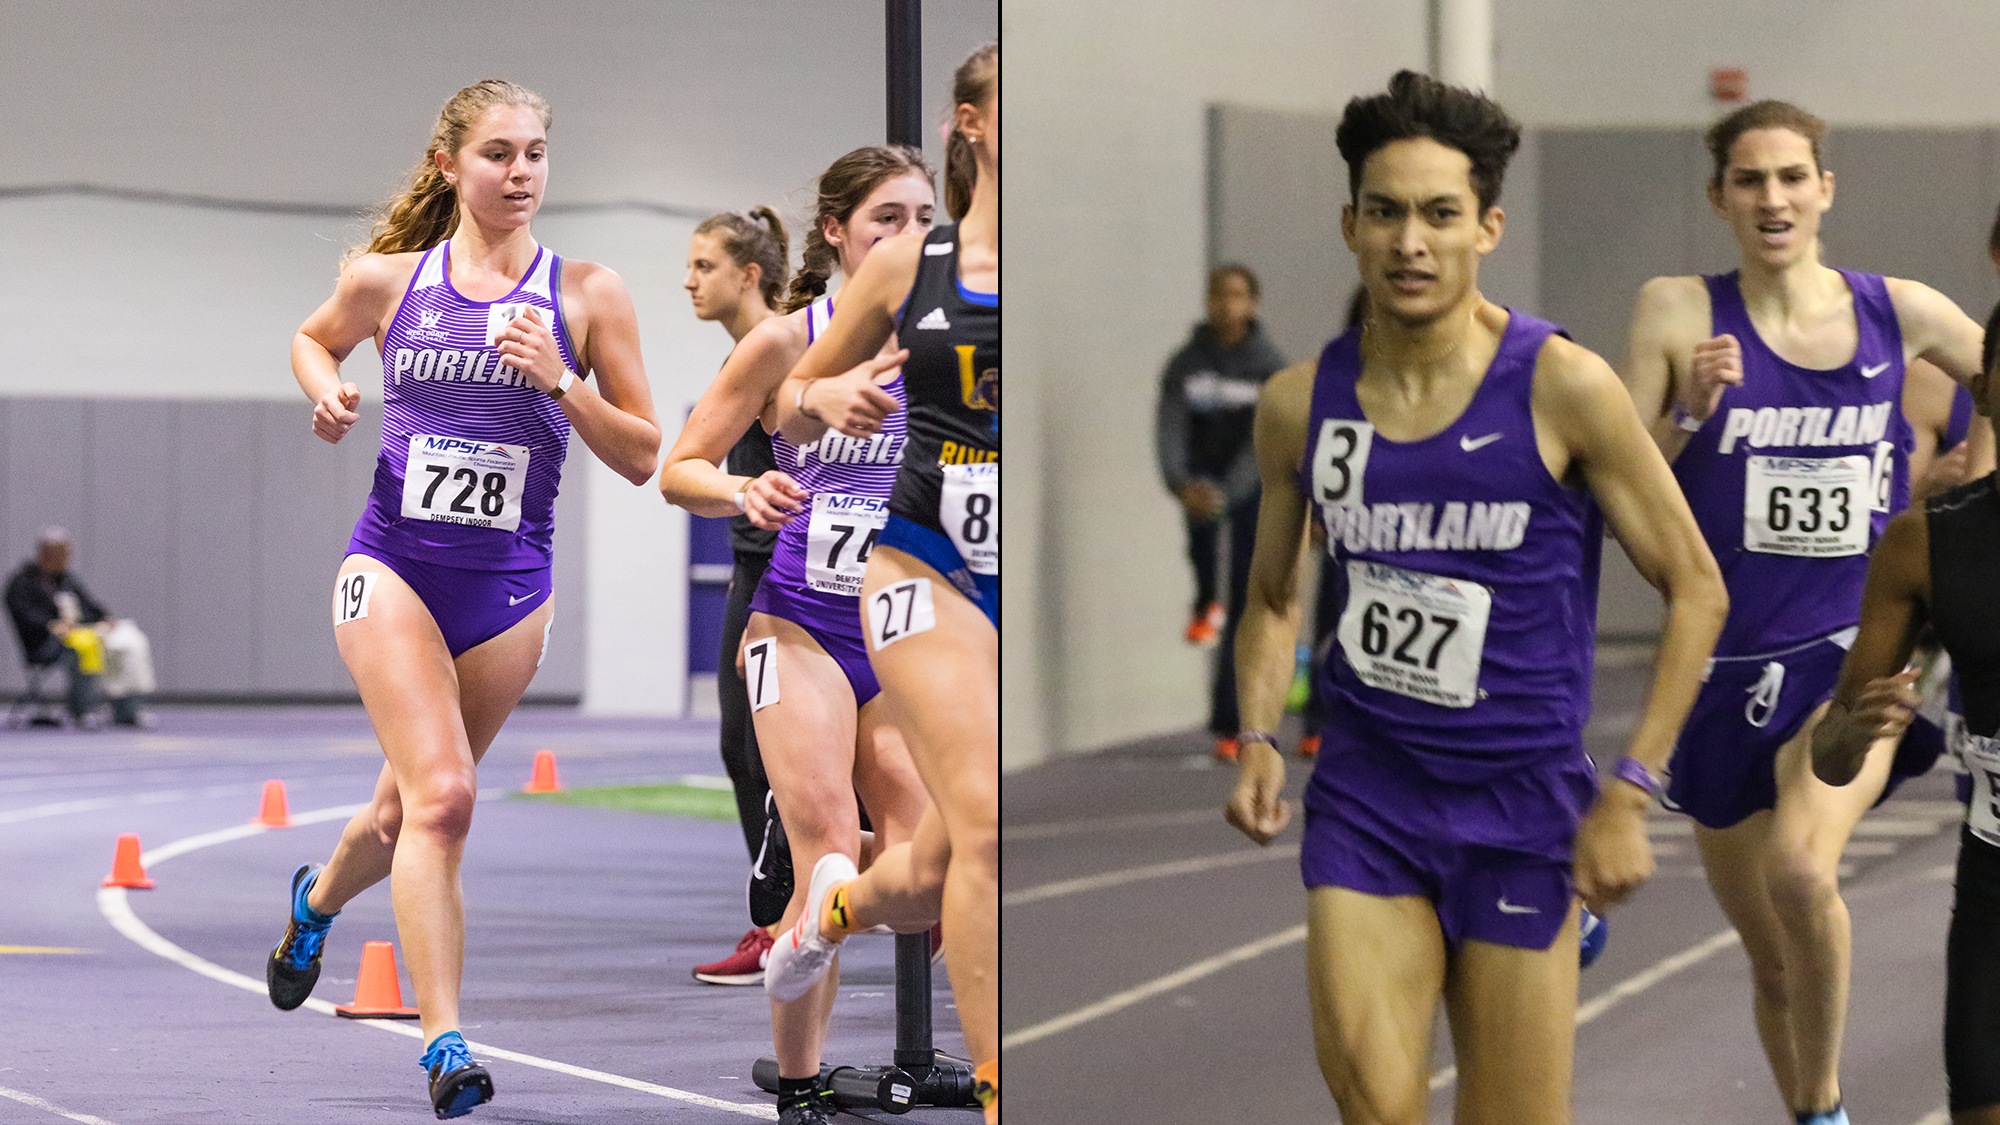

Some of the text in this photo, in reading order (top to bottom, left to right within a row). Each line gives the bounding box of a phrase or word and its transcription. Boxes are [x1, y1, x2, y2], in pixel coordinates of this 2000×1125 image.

[424, 437, 488, 455] MPSF
[474, 461, 515, 472] Championship
[487, 458, 516, 467] Federation
[1323, 426, 1357, 500] 3
[421, 464, 506, 517] 728
[1767, 485, 1849, 533] 633
[431, 513, 492, 527] DEMPSEY INDOOR
[962, 493, 998, 544] 8
[1322, 500, 1532, 559] PORTLAND
[826, 524, 878, 570] 74
[340, 574, 366, 620] 19
[816, 580, 856, 594] UNIVERSITY
[876, 583, 917, 642] 27
[1361, 601, 1459, 670] 627
[750, 643, 768, 705] 7
